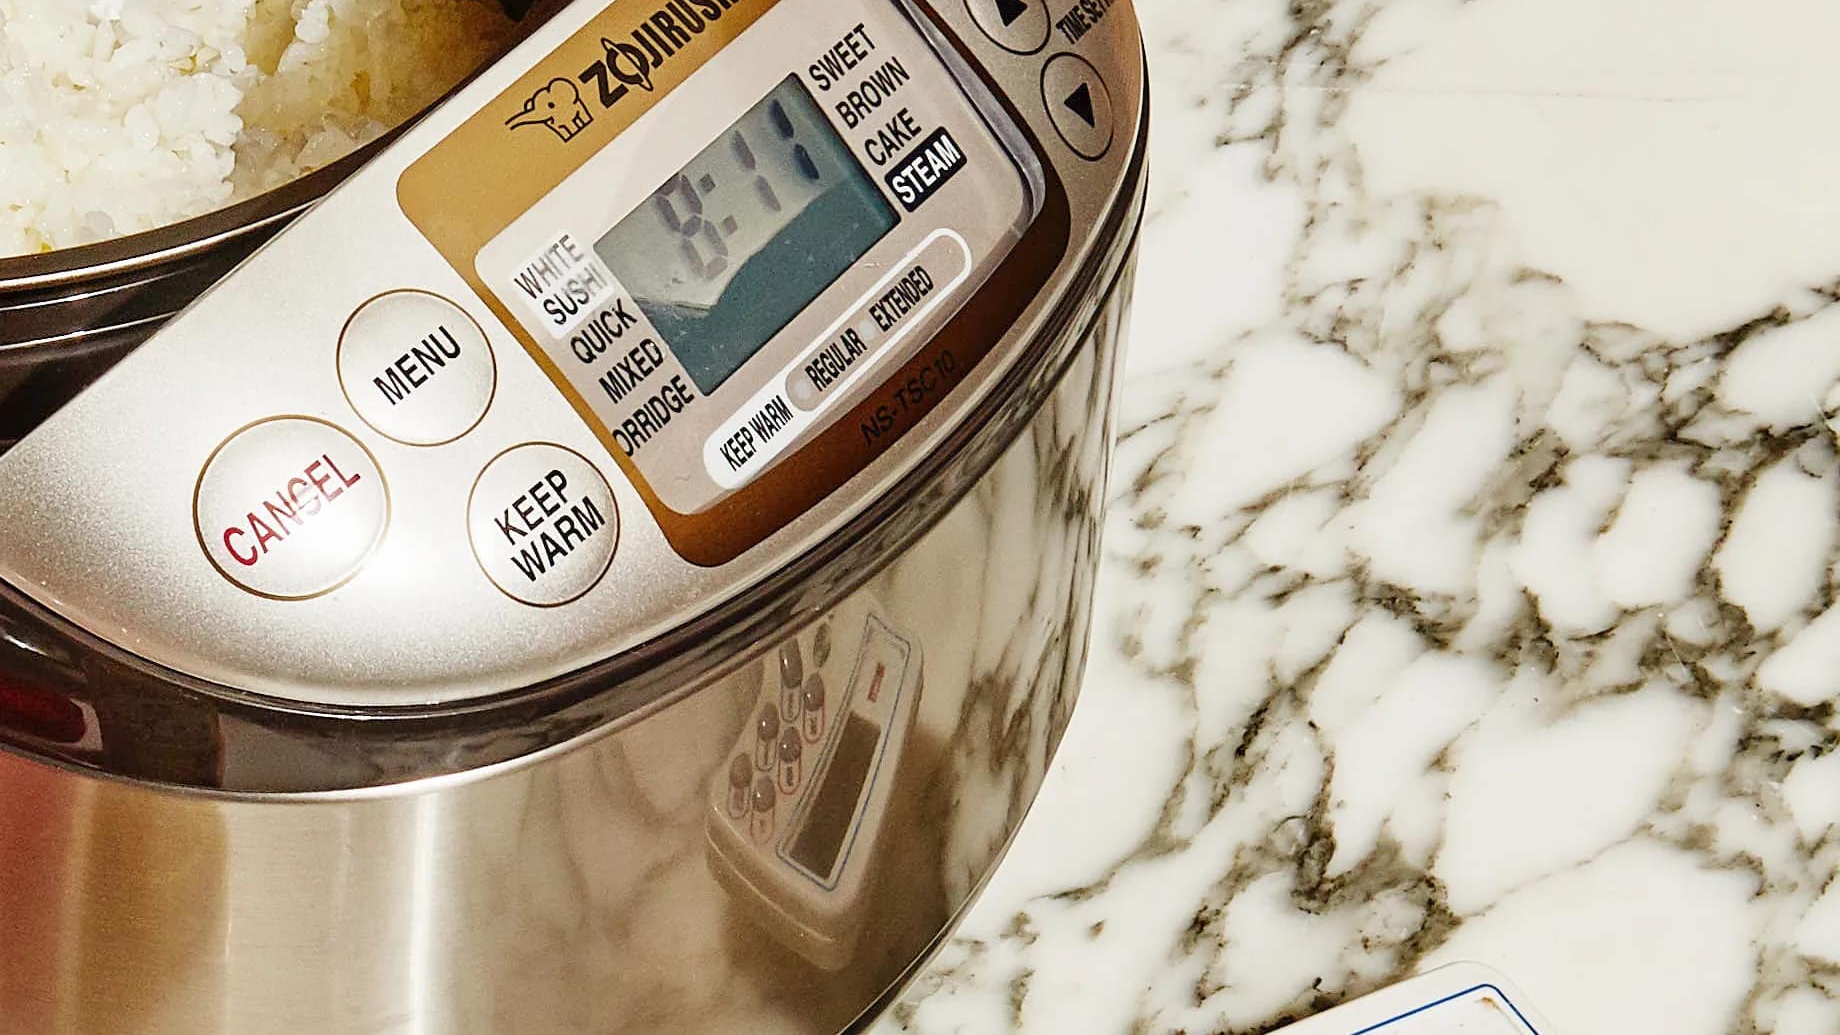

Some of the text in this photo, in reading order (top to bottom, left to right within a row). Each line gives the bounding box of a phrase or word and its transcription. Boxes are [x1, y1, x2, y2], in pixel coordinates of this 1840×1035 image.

[808, 22, 877, 92] SWEET
[1055, 6, 1093, 45] TIME
[834, 55, 910, 130] BROWN
[863, 107, 922, 167] CAKE
[891, 135, 962, 205] STEAM
[653, 98, 820, 280] 8:11
[513, 233, 585, 300] WHITE
[542, 260, 609, 326] SUSHI
[868, 265, 935, 333] EXTENDED
[372, 325, 462, 406] MENU
[570, 297, 639, 365] QUICK
[803, 327, 869, 393] REGULAR
[598, 337, 665, 405] MIXED
[612, 374, 696, 458] ORRIDGE
[719, 395, 795, 472] KEEP WARM
[222, 453, 362, 567] CANCEL
[492, 468, 570, 546] KEEP
[510, 495, 607, 583] WARM
